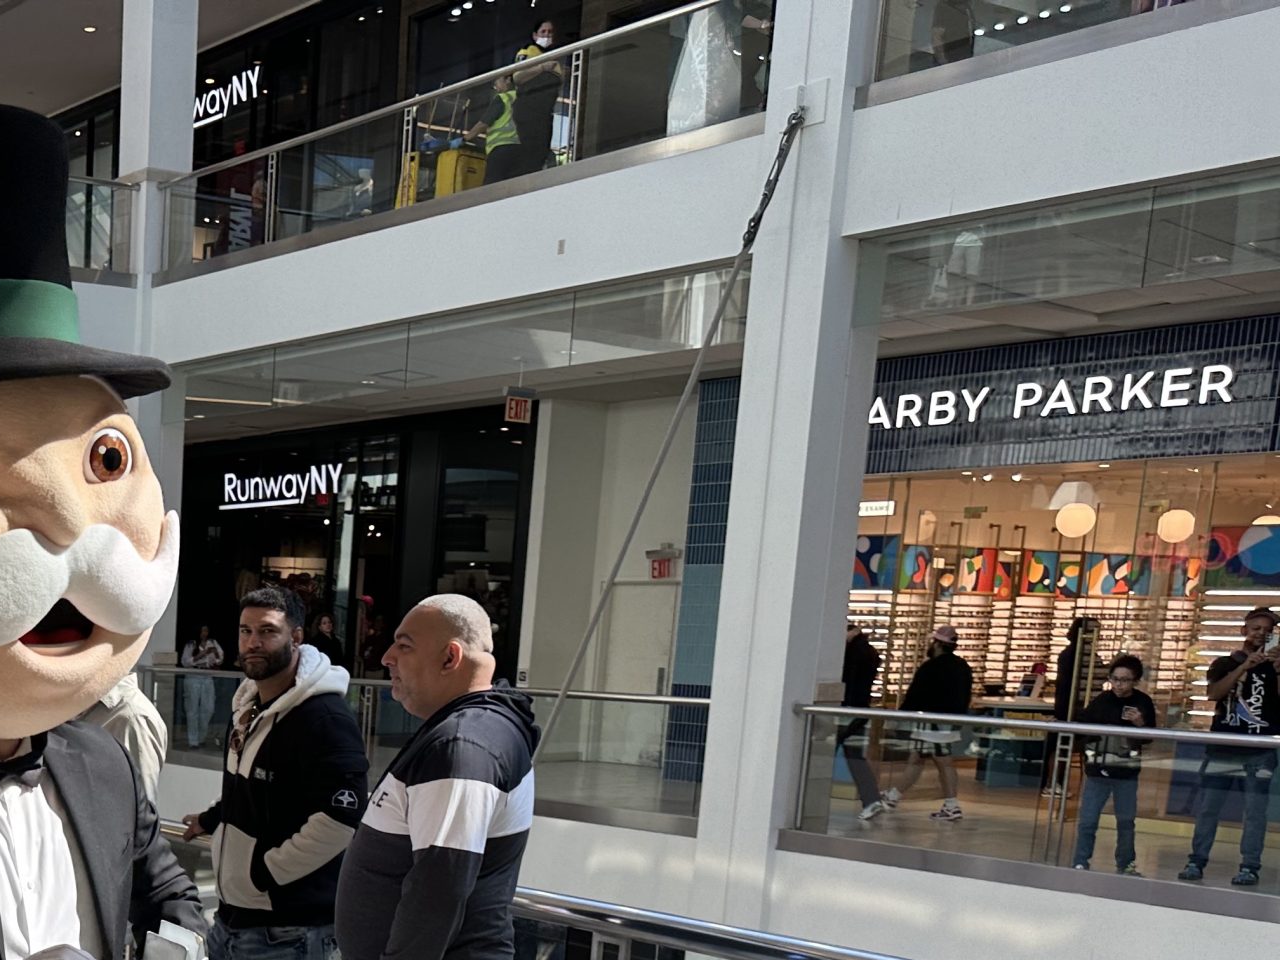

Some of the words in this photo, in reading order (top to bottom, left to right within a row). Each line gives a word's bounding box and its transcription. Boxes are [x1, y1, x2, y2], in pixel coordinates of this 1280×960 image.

[1012, 364, 1234, 420] PARKER
[509, 398, 529, 421] EXIT
[223, 463, 343, 504] RunwayNY
[651, 559, 671, 579] EXIT
